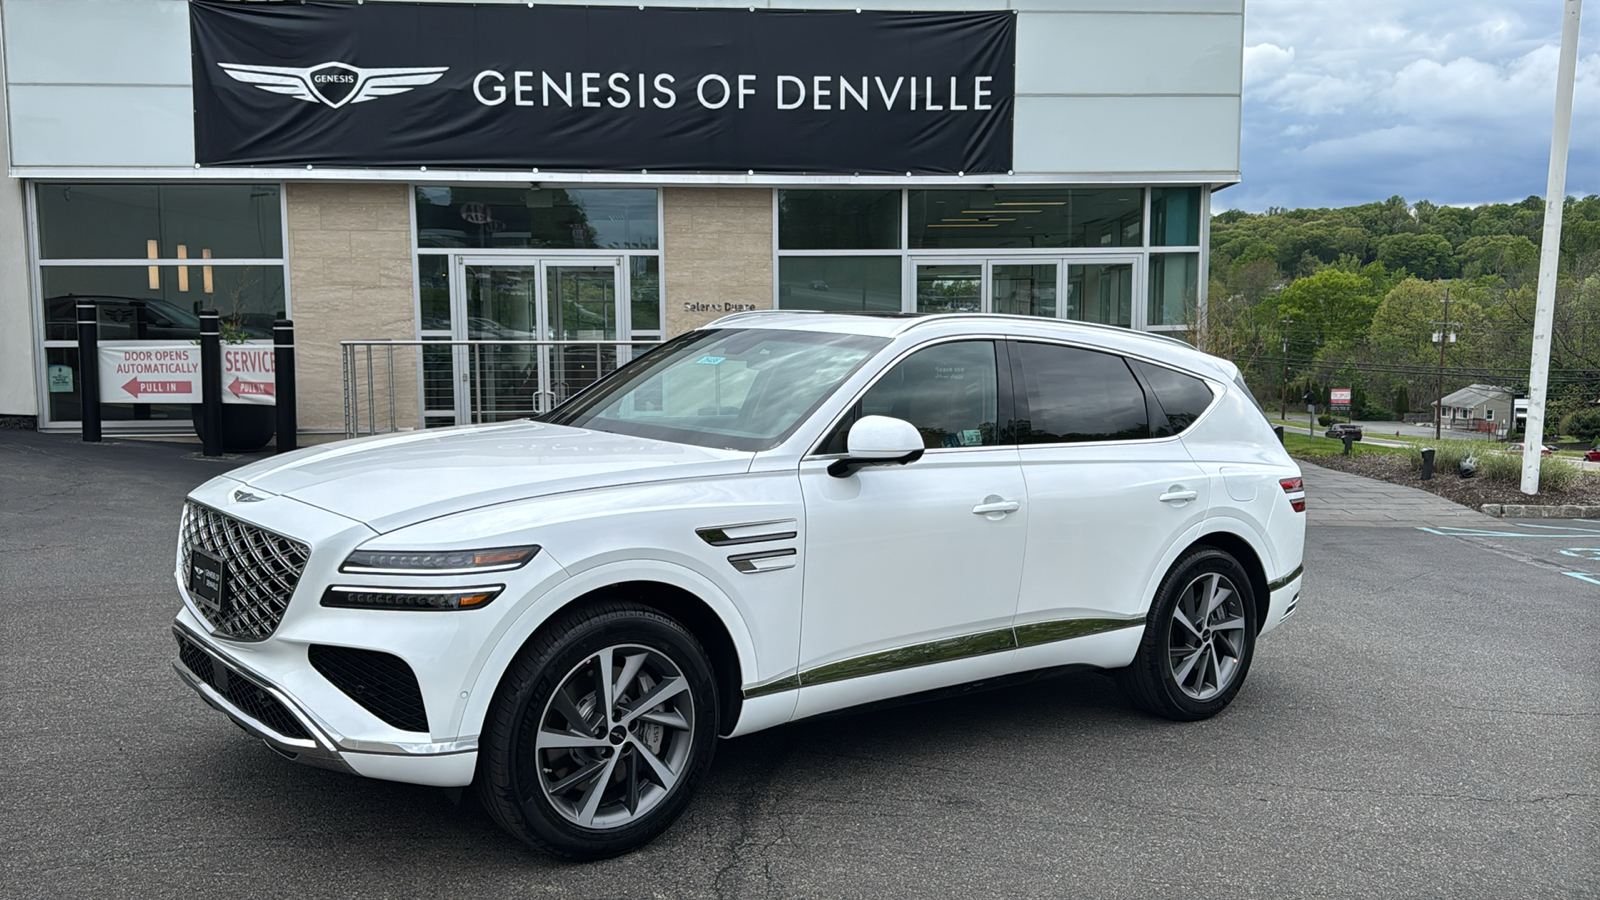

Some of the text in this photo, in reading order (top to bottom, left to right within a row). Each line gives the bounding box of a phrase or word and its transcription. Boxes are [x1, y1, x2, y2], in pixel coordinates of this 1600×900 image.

[314, 74, 354, 83] GENESIS
[472, 69, 993, 111] GENESIS OF DENVILLE
[124, 350, 189, 361] DOOR OPENS
[225, 350, 275, 373] SERVICE
[116, 362, 199, 374] AUTOMATICALLY
[140, 382, 177, 392] PULL IN
[240, 383, 257, 393] PULL
